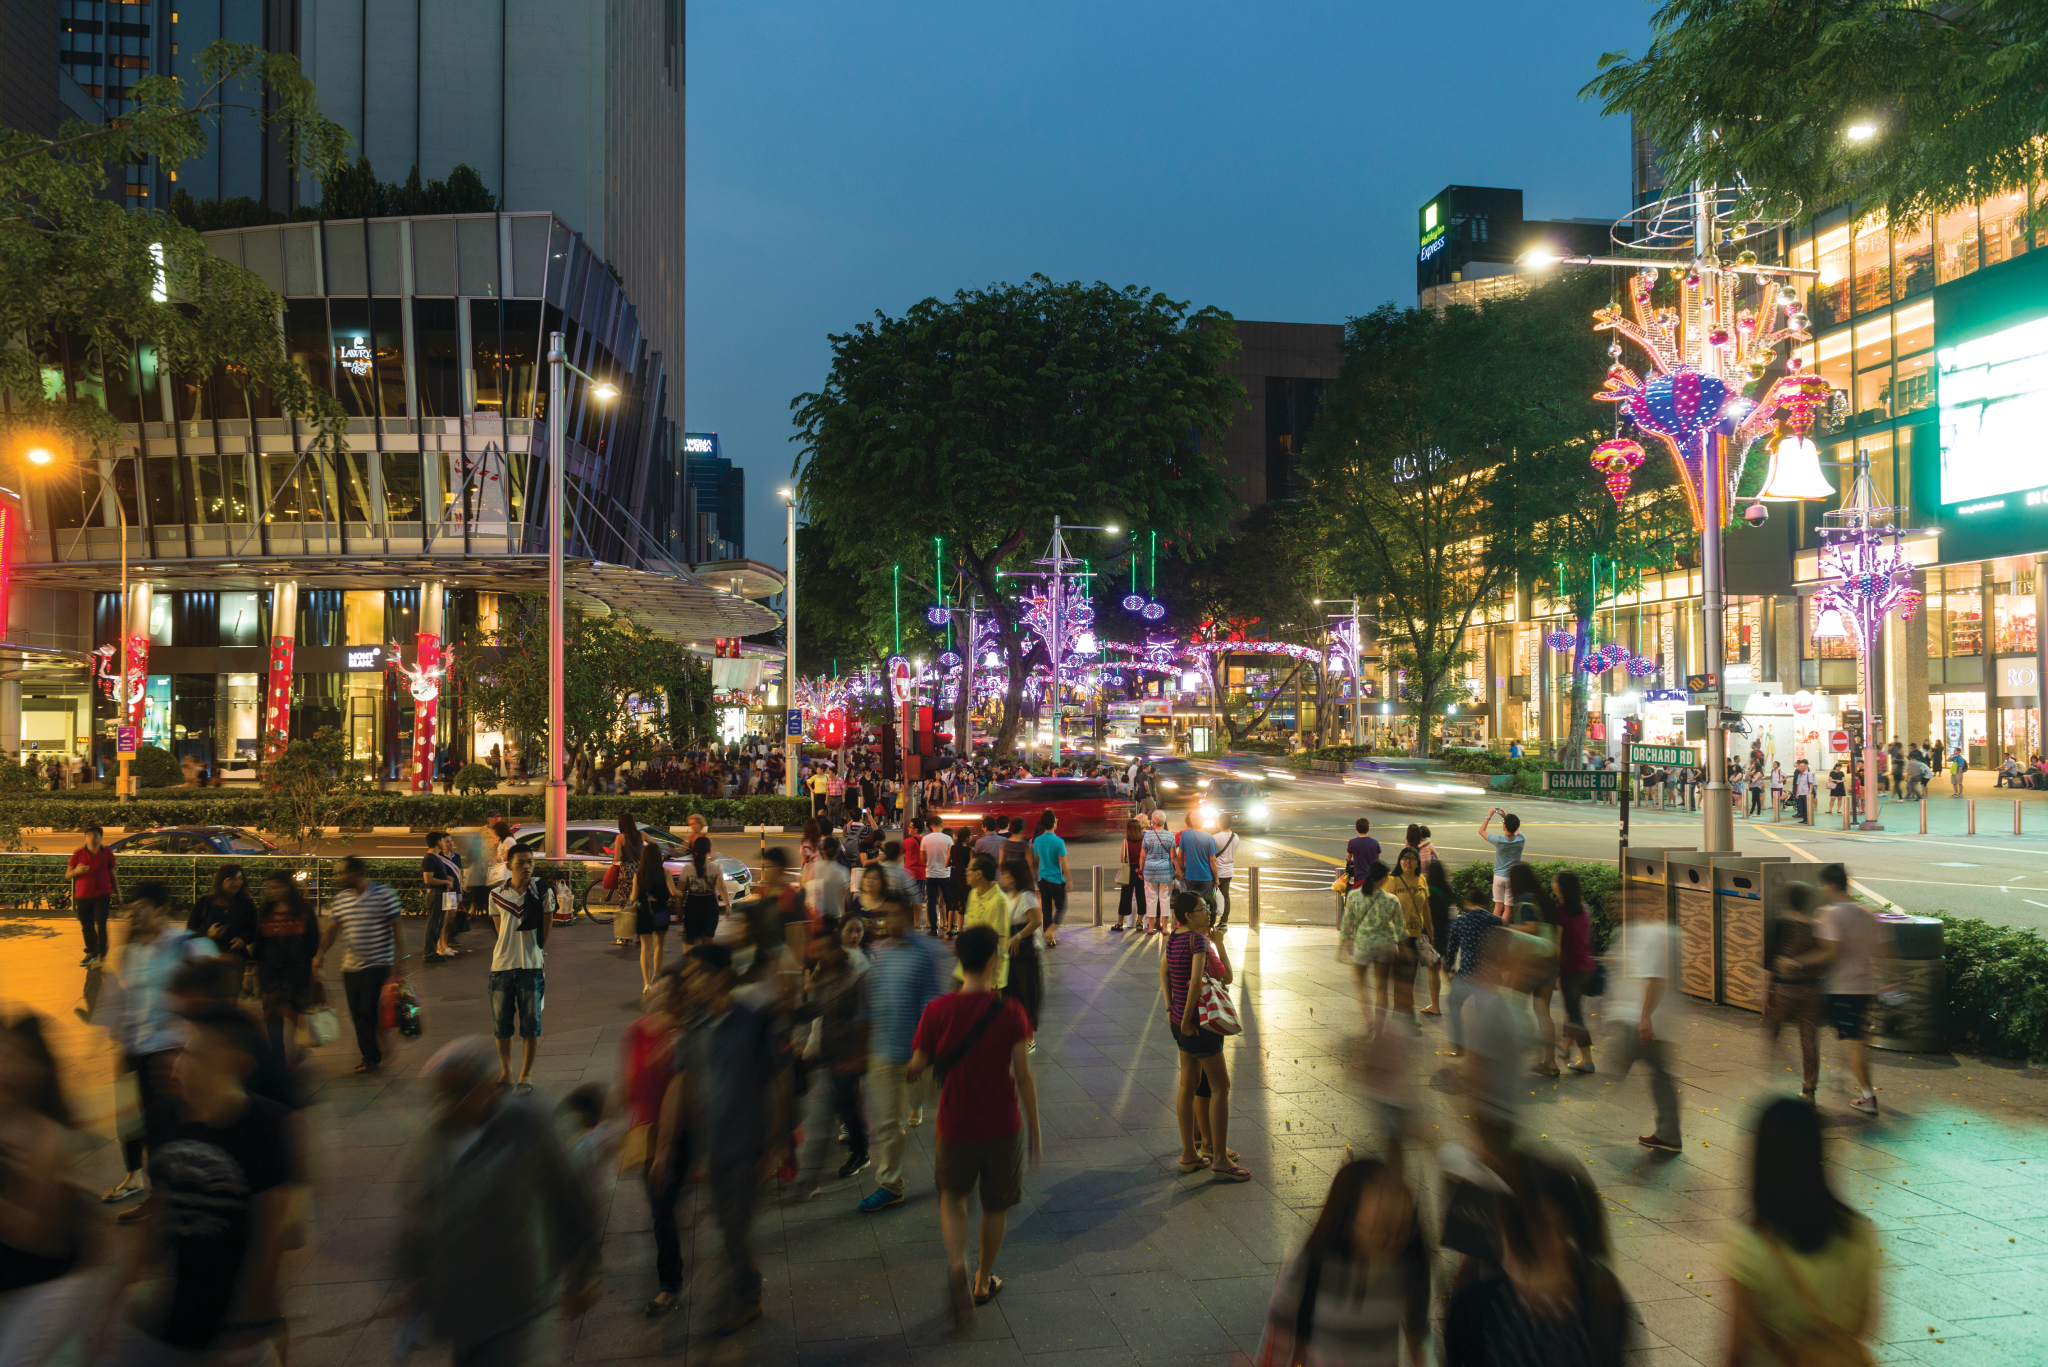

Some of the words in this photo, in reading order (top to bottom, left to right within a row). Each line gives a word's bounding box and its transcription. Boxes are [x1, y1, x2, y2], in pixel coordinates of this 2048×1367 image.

[1421, 236, 1445, 261] Express
[340, 346, 372, 360] LAWRY
[686, 438, 712, 447] WISMA
[348, 652, 374, 660] MONT
[348, 659, 375, 668] BLANC
[1664, 625, 1674, 690] ROBINSON
[1530, 639, 1539, 702] ROBINSONS
[2007, 668, 2036, 687] RO
[1633, 747, 1677, 764] ORCHARD
[1679, 750, 1693, 765] RD
[1551, 773, 1597, 788] GRANGE
[1600, 774, 1615, 788] RD
